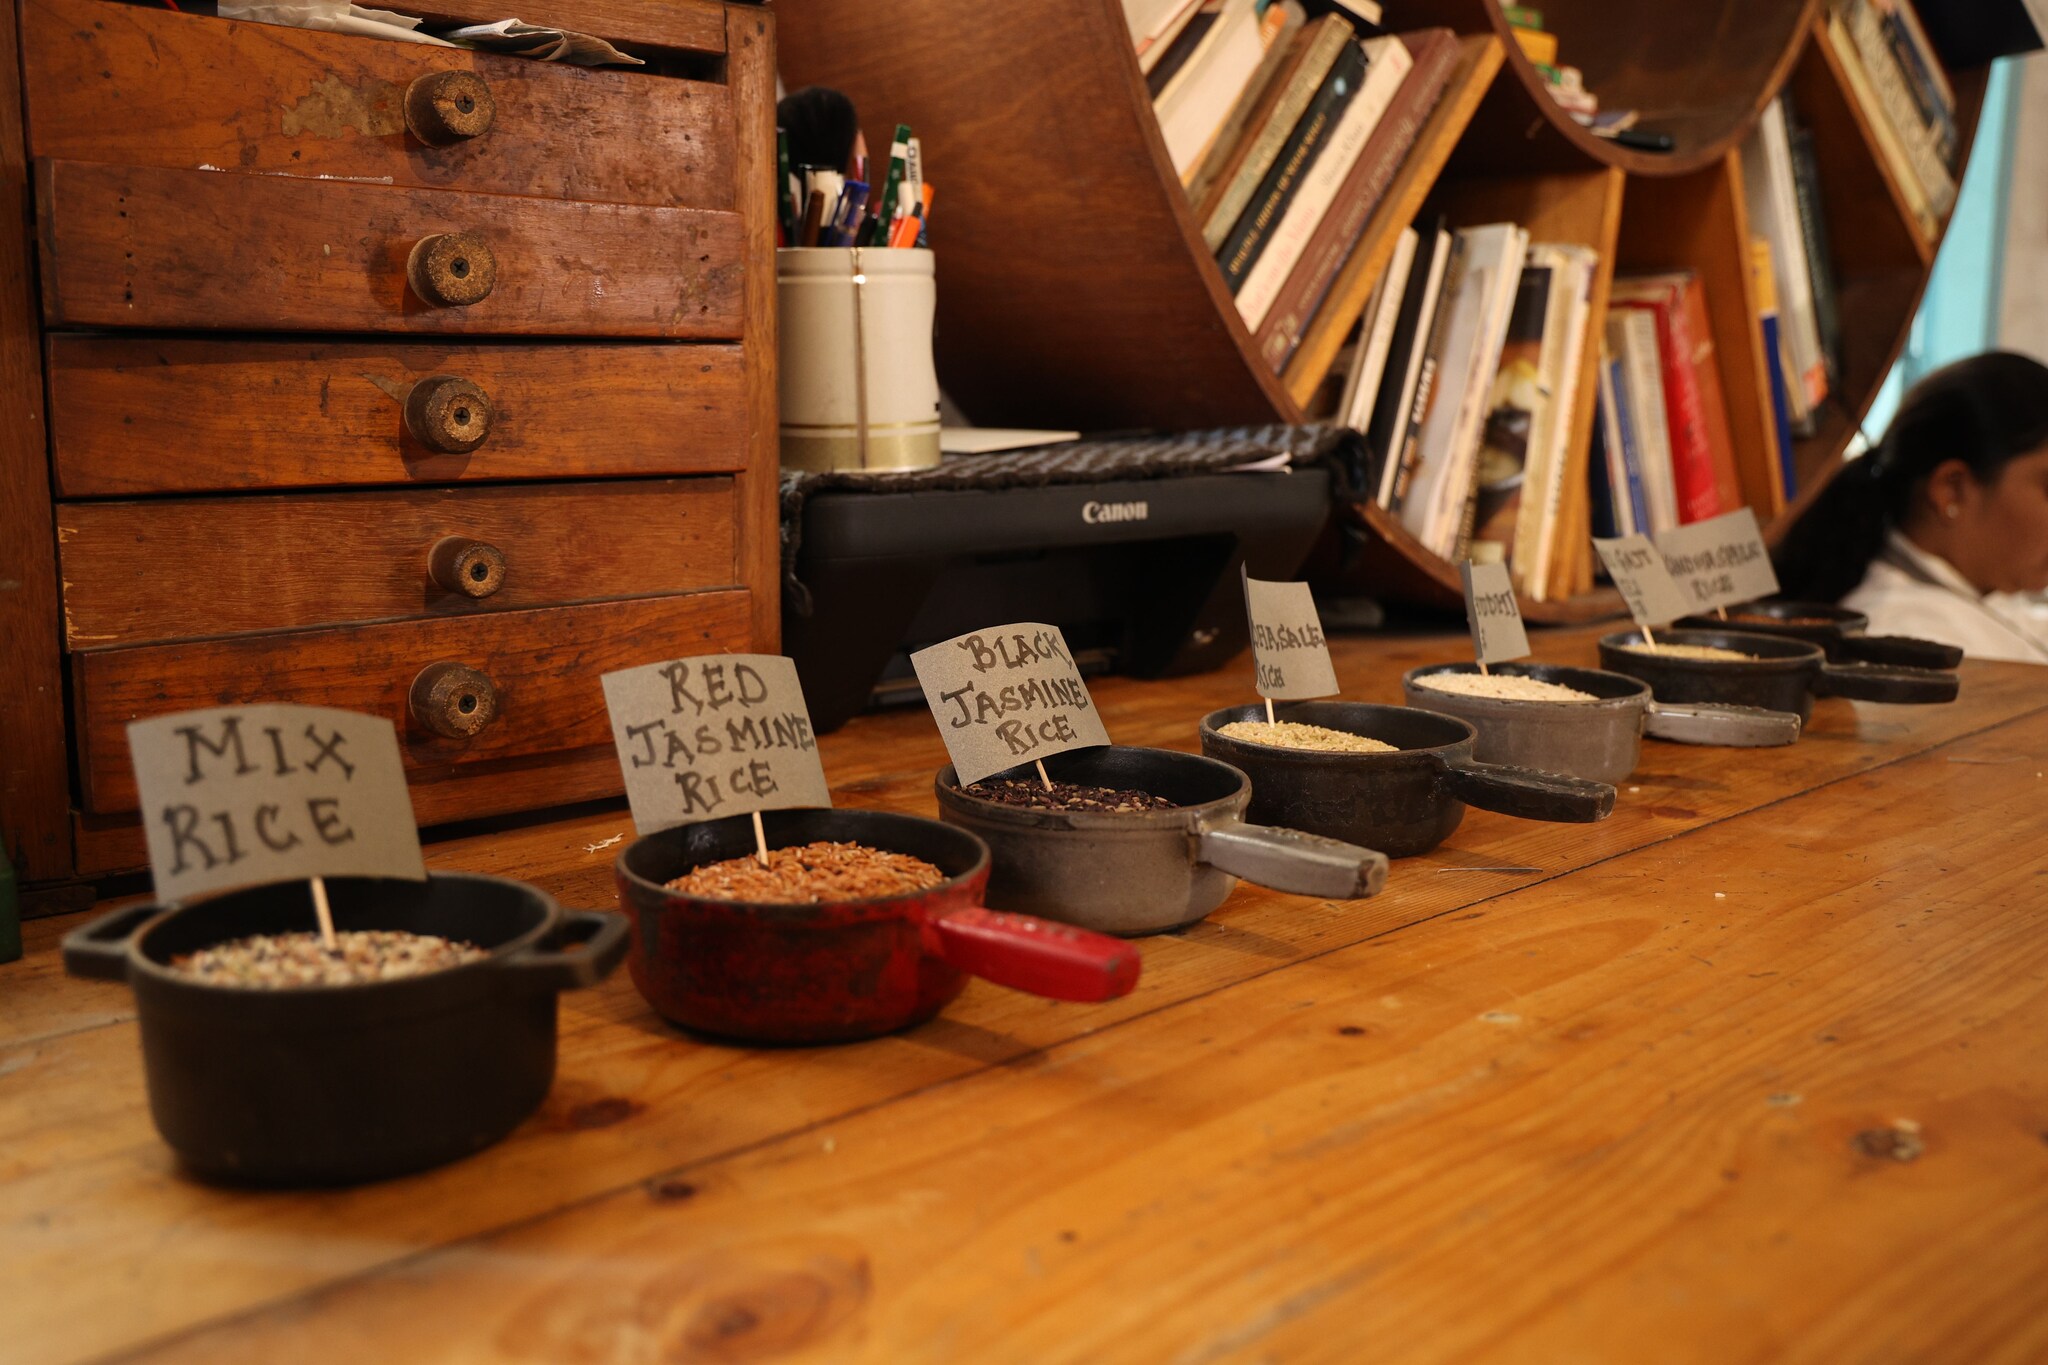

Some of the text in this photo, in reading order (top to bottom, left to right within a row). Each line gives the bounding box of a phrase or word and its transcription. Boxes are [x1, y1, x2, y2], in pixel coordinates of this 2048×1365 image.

[1082, 501, 1148, 524] Canon
[957, 630, 1074, 673] BLACK
[661, 661, 769, 715] RED
[940, 676, 1089, 729] JASMINE
[174, 715, 356, 785] MIX
[627, 711, 816, 769] JASMINE
[996, 714, 1078, 756] RICE
[676, 759, 779, 814] RICE
[162, 797, 356, 875] RICE
